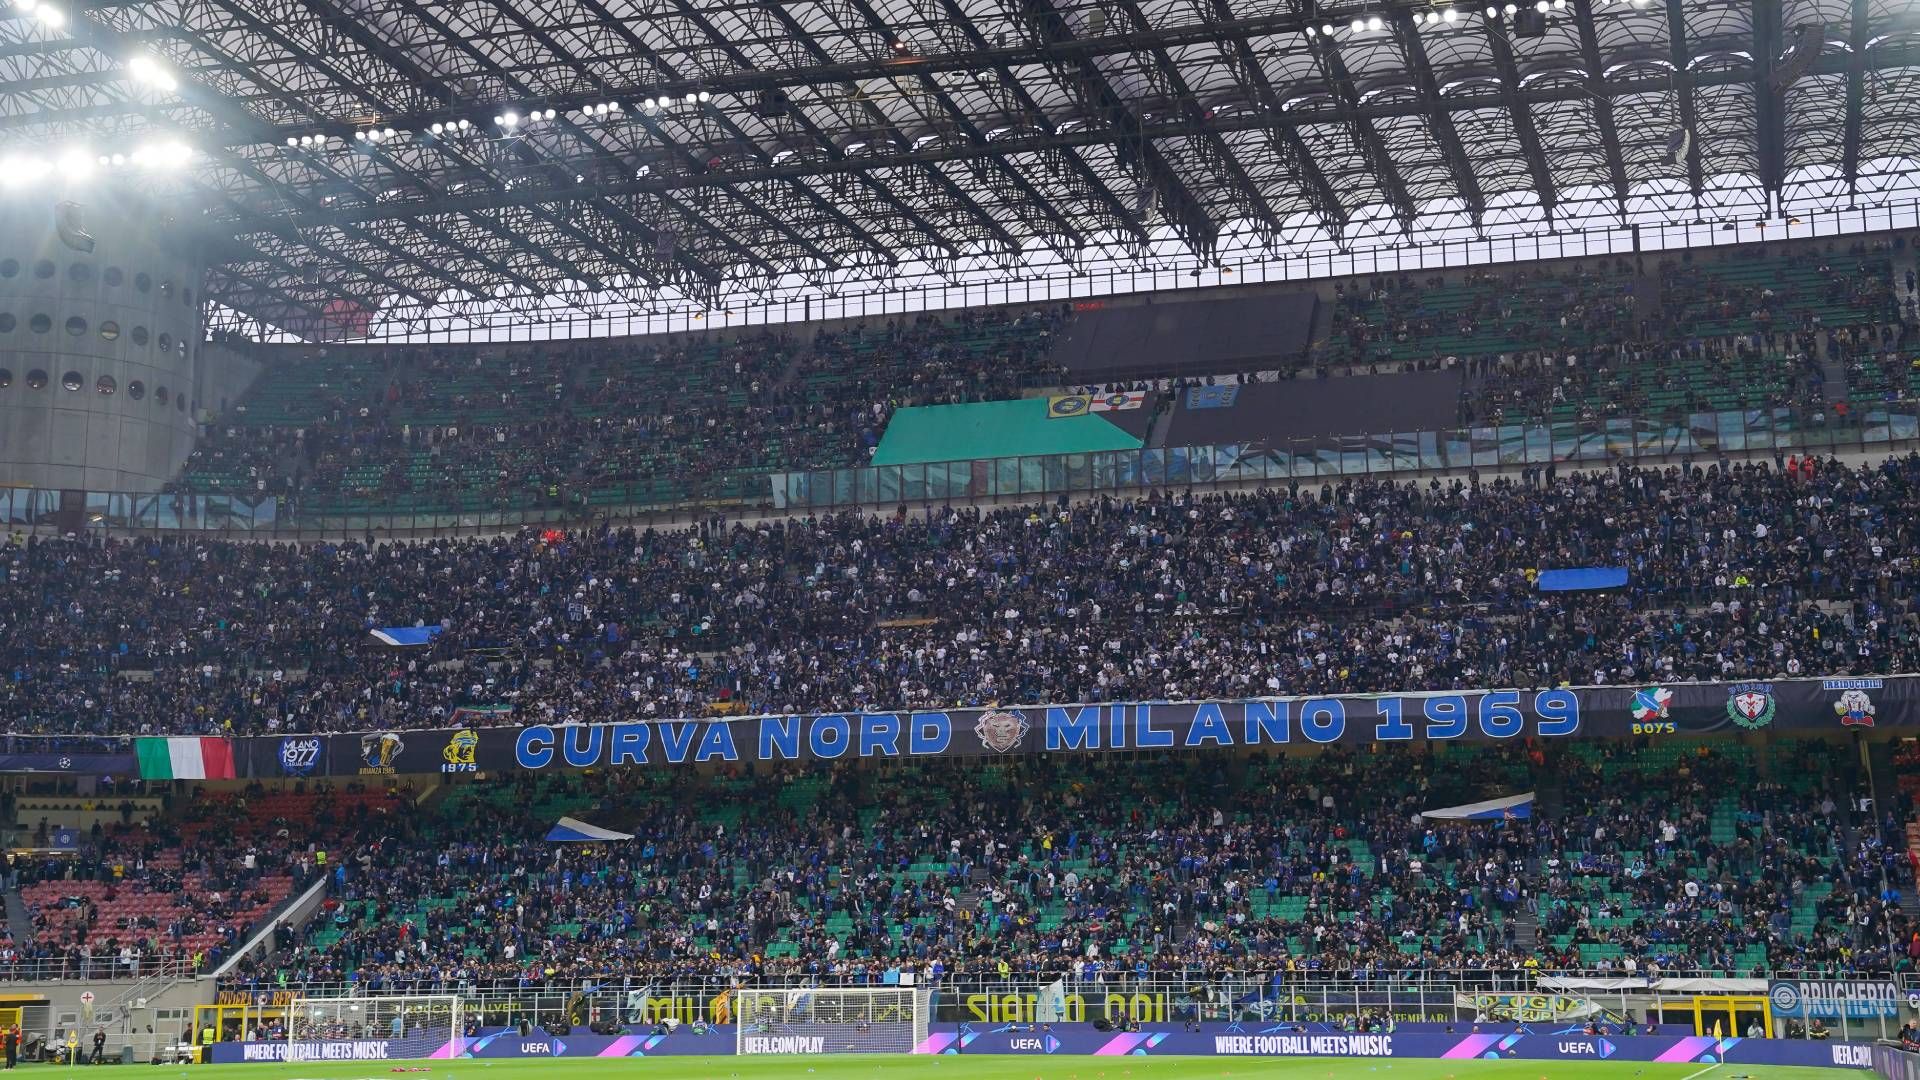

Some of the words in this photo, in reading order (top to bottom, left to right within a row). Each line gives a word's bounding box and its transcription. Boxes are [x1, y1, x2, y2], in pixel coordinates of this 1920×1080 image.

[1824, 680, 1882, 689] IRRIDUCIBILI
[515, 720, 738, 768] CURVA
[758, 711, 953, 760] NORD
[1045, 698, 1346, 750] MILANO
[1375, 688, 1580, 741] 1969
[1632, 722, 1675, 735] BOYS
[284, 740, 319, 749] MILANO
[283, 748, 319, 762] 1977
[441, 763, 477, 772] 1975
[1800, 982, 1897, 1016] BRUGHERIO
[244, 1044, 275, 1060] WHERE
[276, 1043, 320, 1059] FOTBALL
[321, 1042, 352, 1059] MEETS
[353, 1041, 388, 1059] MUSIC
[521, 1042, 551, 1053] UEFA
[745, 1035, 825, 1054] UEFA.COM/PLAY
[1010, 1038, 1043, 1050] UEFA
[1215, 1036, 1253, 1054] WHERE
[1254, 1036, 1309, 1054] FOOTBALL
[1310, 1036, 1347, 1055] MEETS
[1348, 1035, 1393, 1056] MUSIC
[1558, 1042, 1595, 1054] UEFA
